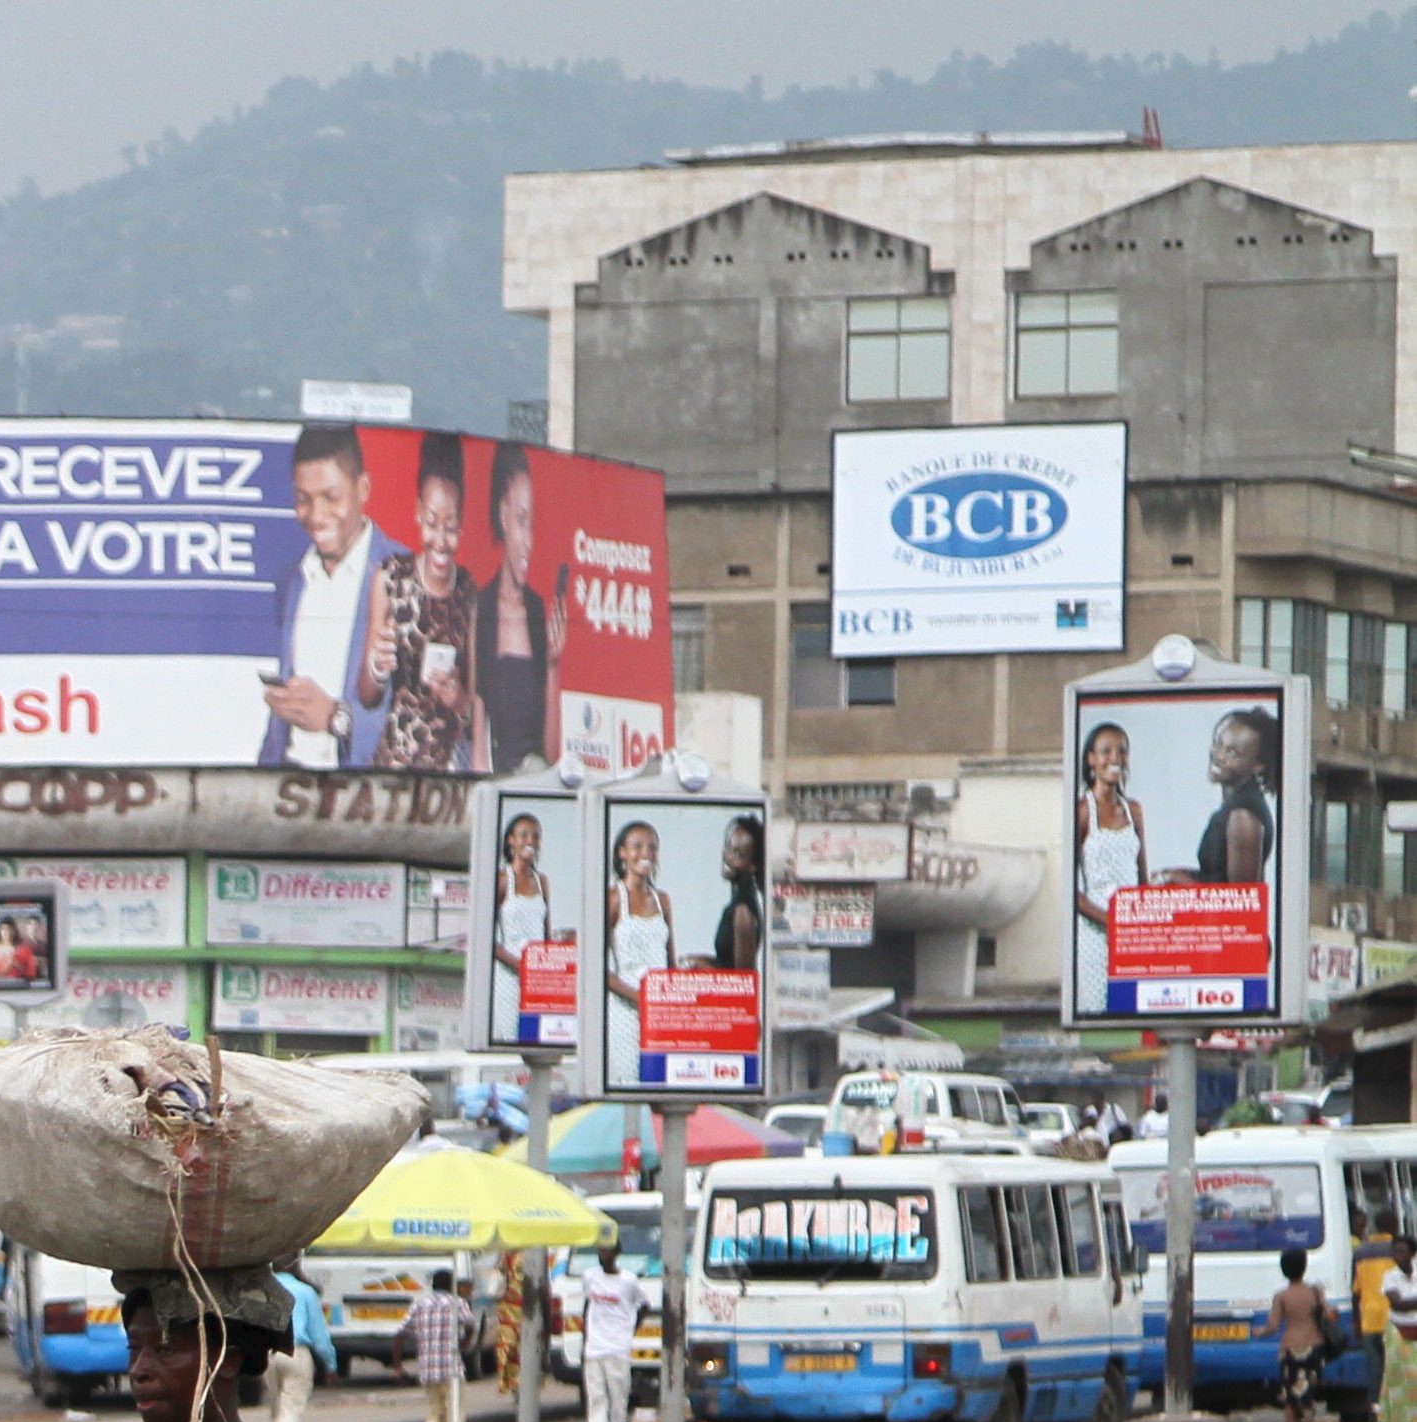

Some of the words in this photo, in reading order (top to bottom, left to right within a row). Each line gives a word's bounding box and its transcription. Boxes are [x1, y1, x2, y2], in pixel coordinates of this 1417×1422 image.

[885, 453, 965, 492] BANQUE
[972, 451, 999, 467] DE
[906, 489, 1053, 543] BCB
[45, 520, 255, 575] VOTRE
[574, 528, 652, 574] Composez
[921, 552, 1040, 577] BUJUMBURA
[839, 607, 913, 634] BCB
[276, 774, 465, 826] STATION
[1200, 887, 1259, 899] FAMILLE
[1197, 987, 1235, 1006] leo
